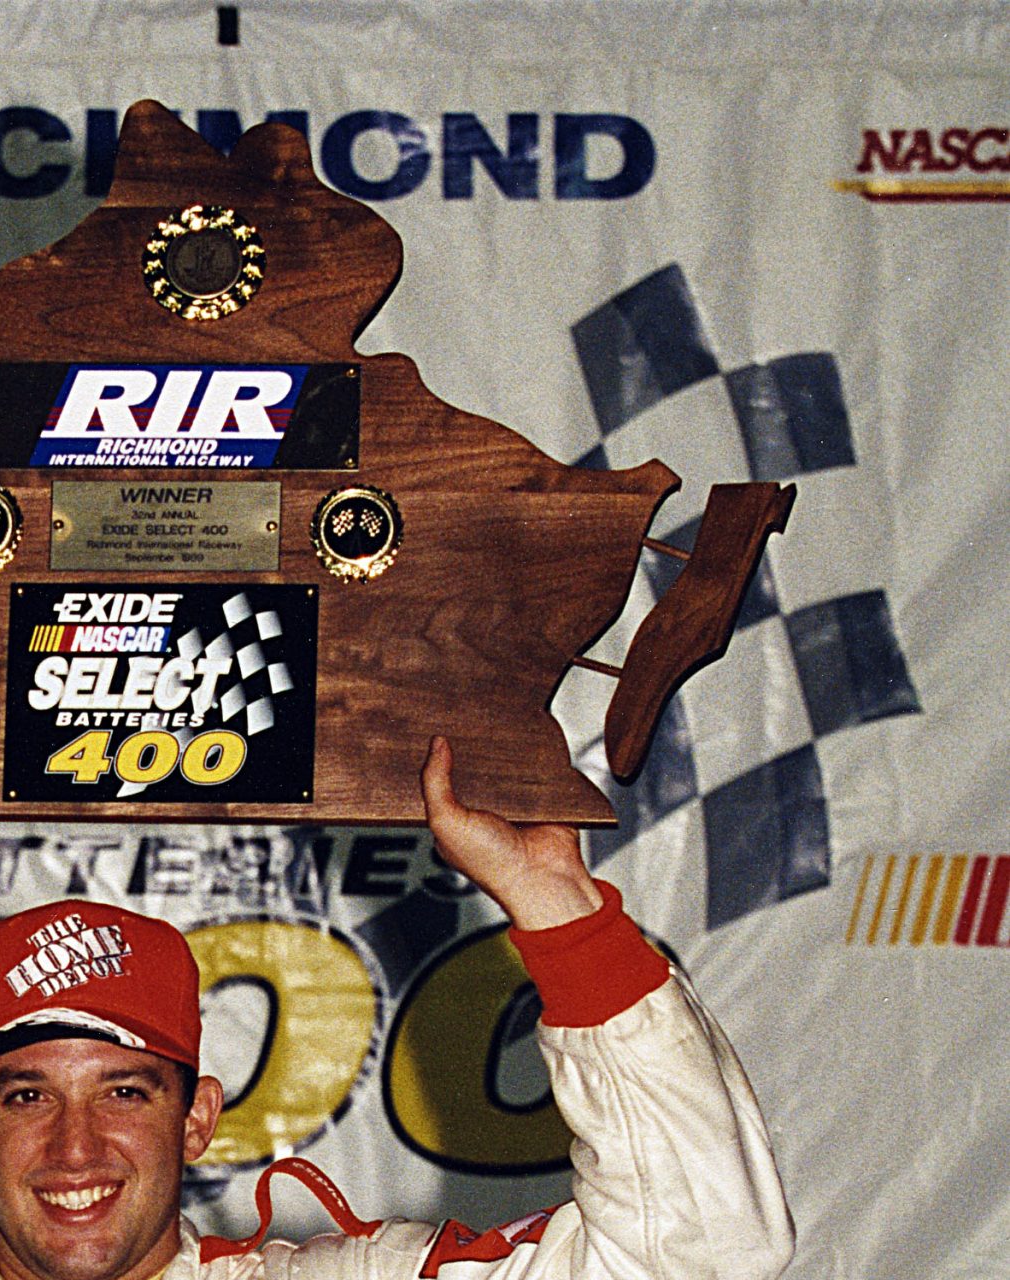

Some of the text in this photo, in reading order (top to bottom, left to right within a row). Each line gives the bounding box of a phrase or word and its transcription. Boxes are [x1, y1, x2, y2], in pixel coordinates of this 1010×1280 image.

[42, 370, 293, 439] RIR
[49, 454, 254, 467] INTERNATIONAL RACEWAY
[96, 439, 219, 455] RICHMOND
[120, 487, 213, 503] WINNER
[161, 510, 199, 519] ANNUAL
[102, 525, 229, 535] EXIDE SELECT 400
[87, 540, 132, 549] Richmond
[198, 541, 242, 550] Raceway
[53, 593, 180, 623] EXIDE
[70, 625, 167, 652] NASCAR
[28, 656, 233, 714] SELECT
[55, 711, 206, 727] BATTERIES
[44, 729, 248, 786] 400
[26, 913, 88, 949] THE
[4, 924, 133, 998] HOME
[38, 956, 125, 998] DEPOT
